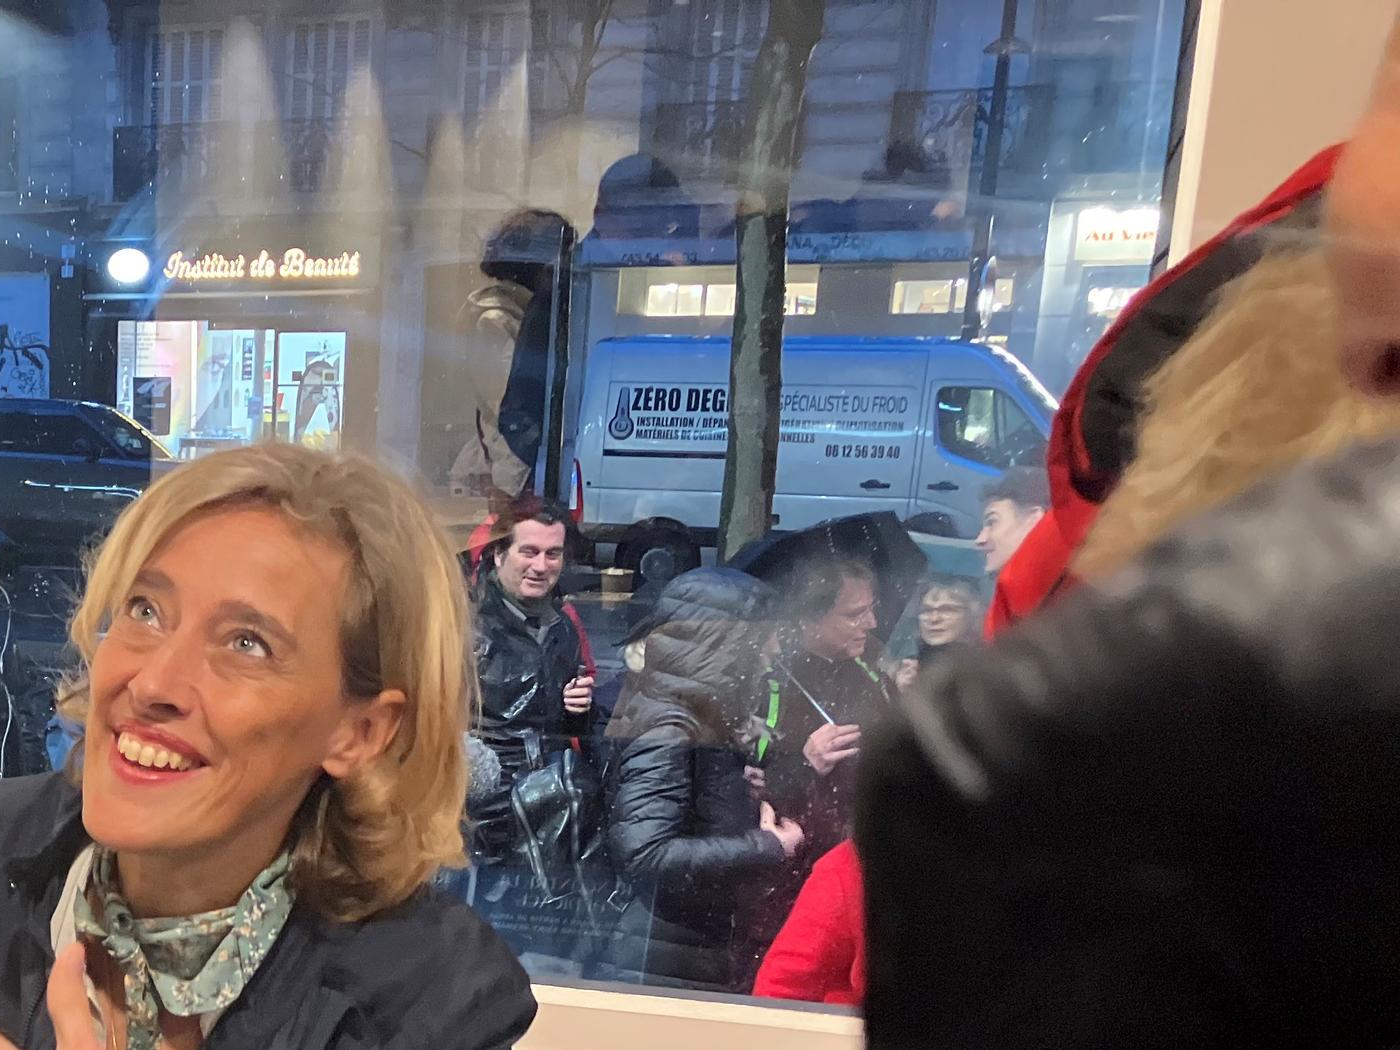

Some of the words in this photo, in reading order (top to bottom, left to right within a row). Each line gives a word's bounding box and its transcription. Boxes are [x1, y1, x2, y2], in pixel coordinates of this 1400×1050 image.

[163, 250, 245, 280] Institut
[250, 249, 276, 278] de
[280, 247, 360, 278] Beauté
[632, 385, 682, 412] ZÉRO
[686, 388, 729, 412] DEG
[852, 395, 870, 413] DU
[872, 396, 908, 414] FROID
[636, 416, 695, 428] INSTALLATION
[635, 428, 680, 440] MATÉRIELS
[825, 444, 839, 458] 06
[841, 444, 852, 458] 12
[887, 446, 900, 459] 40
